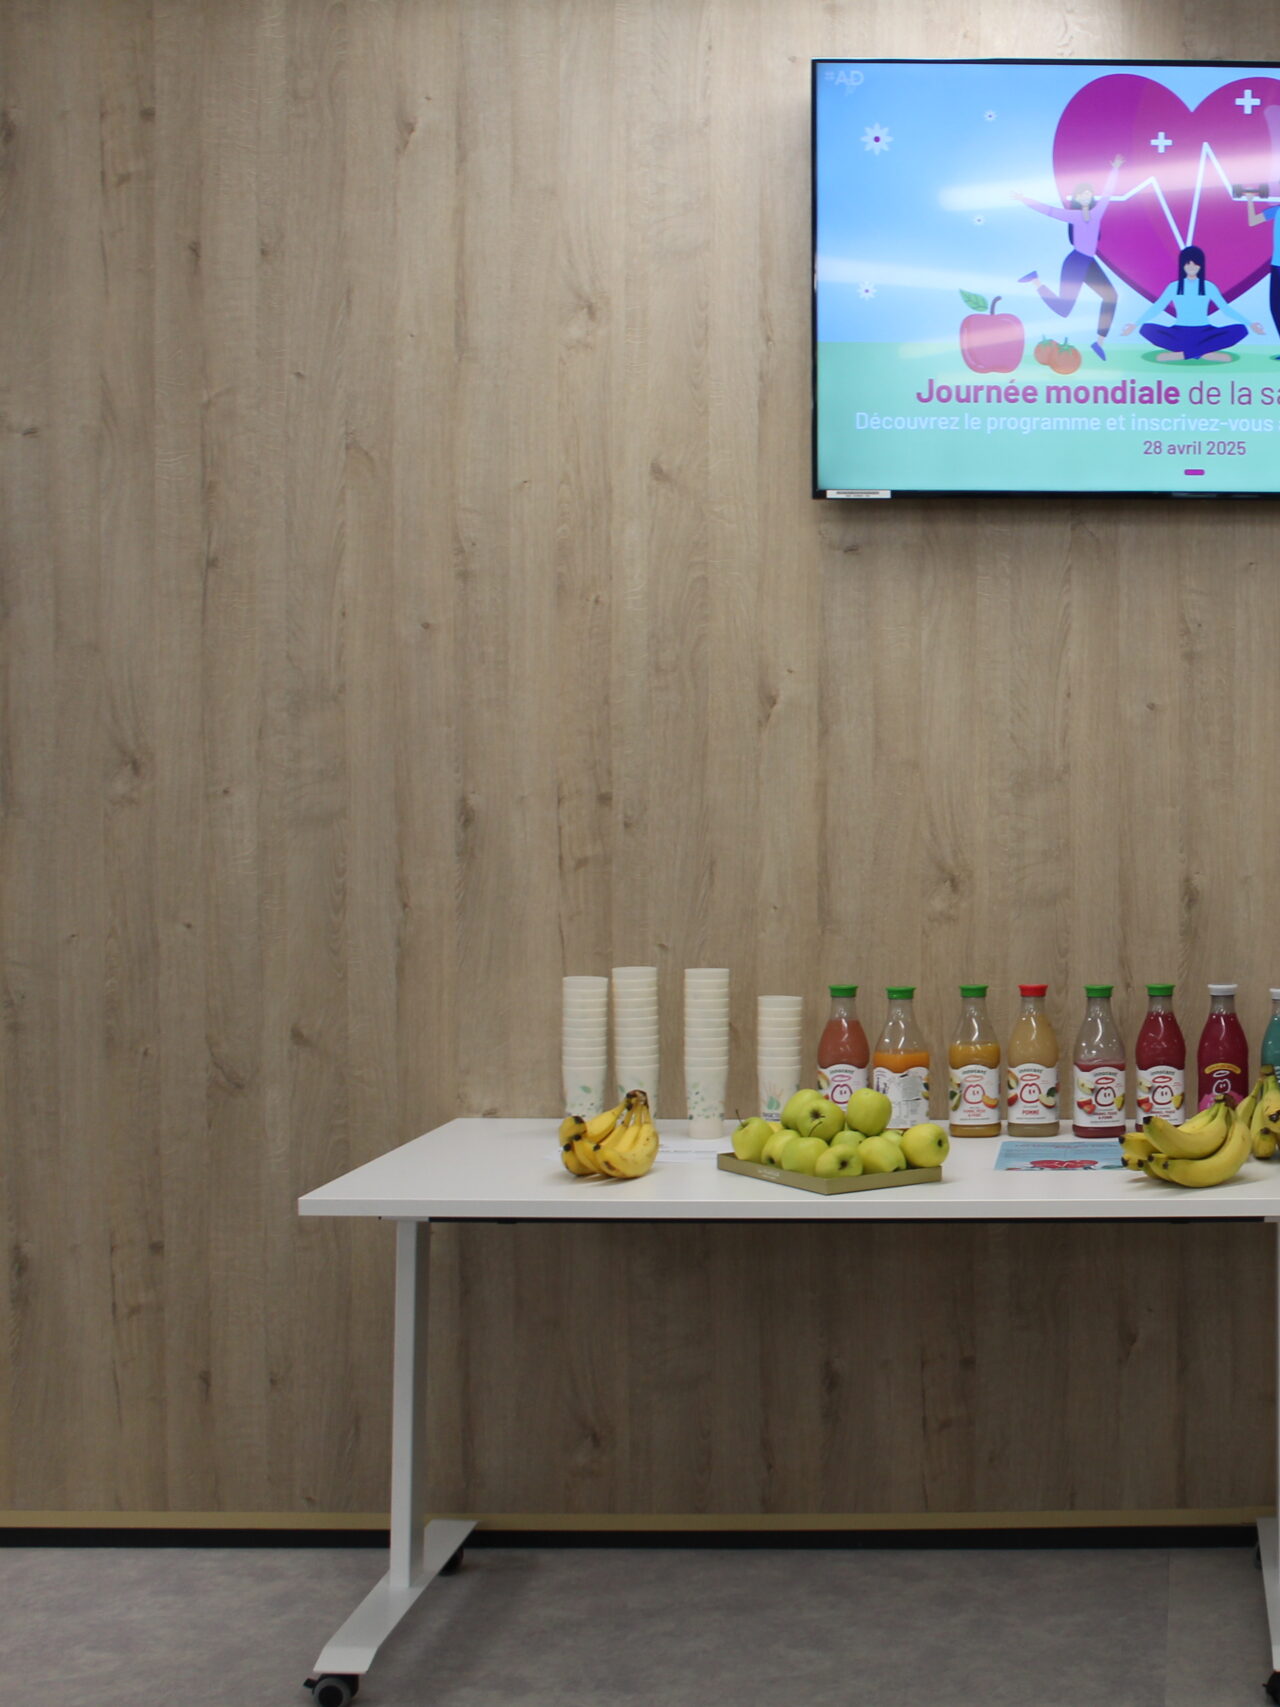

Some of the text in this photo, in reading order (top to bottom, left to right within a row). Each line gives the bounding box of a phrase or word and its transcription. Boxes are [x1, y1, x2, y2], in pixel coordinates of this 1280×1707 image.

[916, 378, 1038, 404] Journée
[1045, 379, 1181, 405] mondiale
[1188, 380, 1221, 406] de
[1230, 380, 1252, 406] la
[855, 411, 960, 430] Découvrez
[964, 412, 981, 431] le
[987, 416, 1100, 435] programme
[1105, 414, 1126, 431] et
[1131, 413, 1274, 433] inscrivez-vous
[1143, 440, 1247, 456] 28 avril 2025
